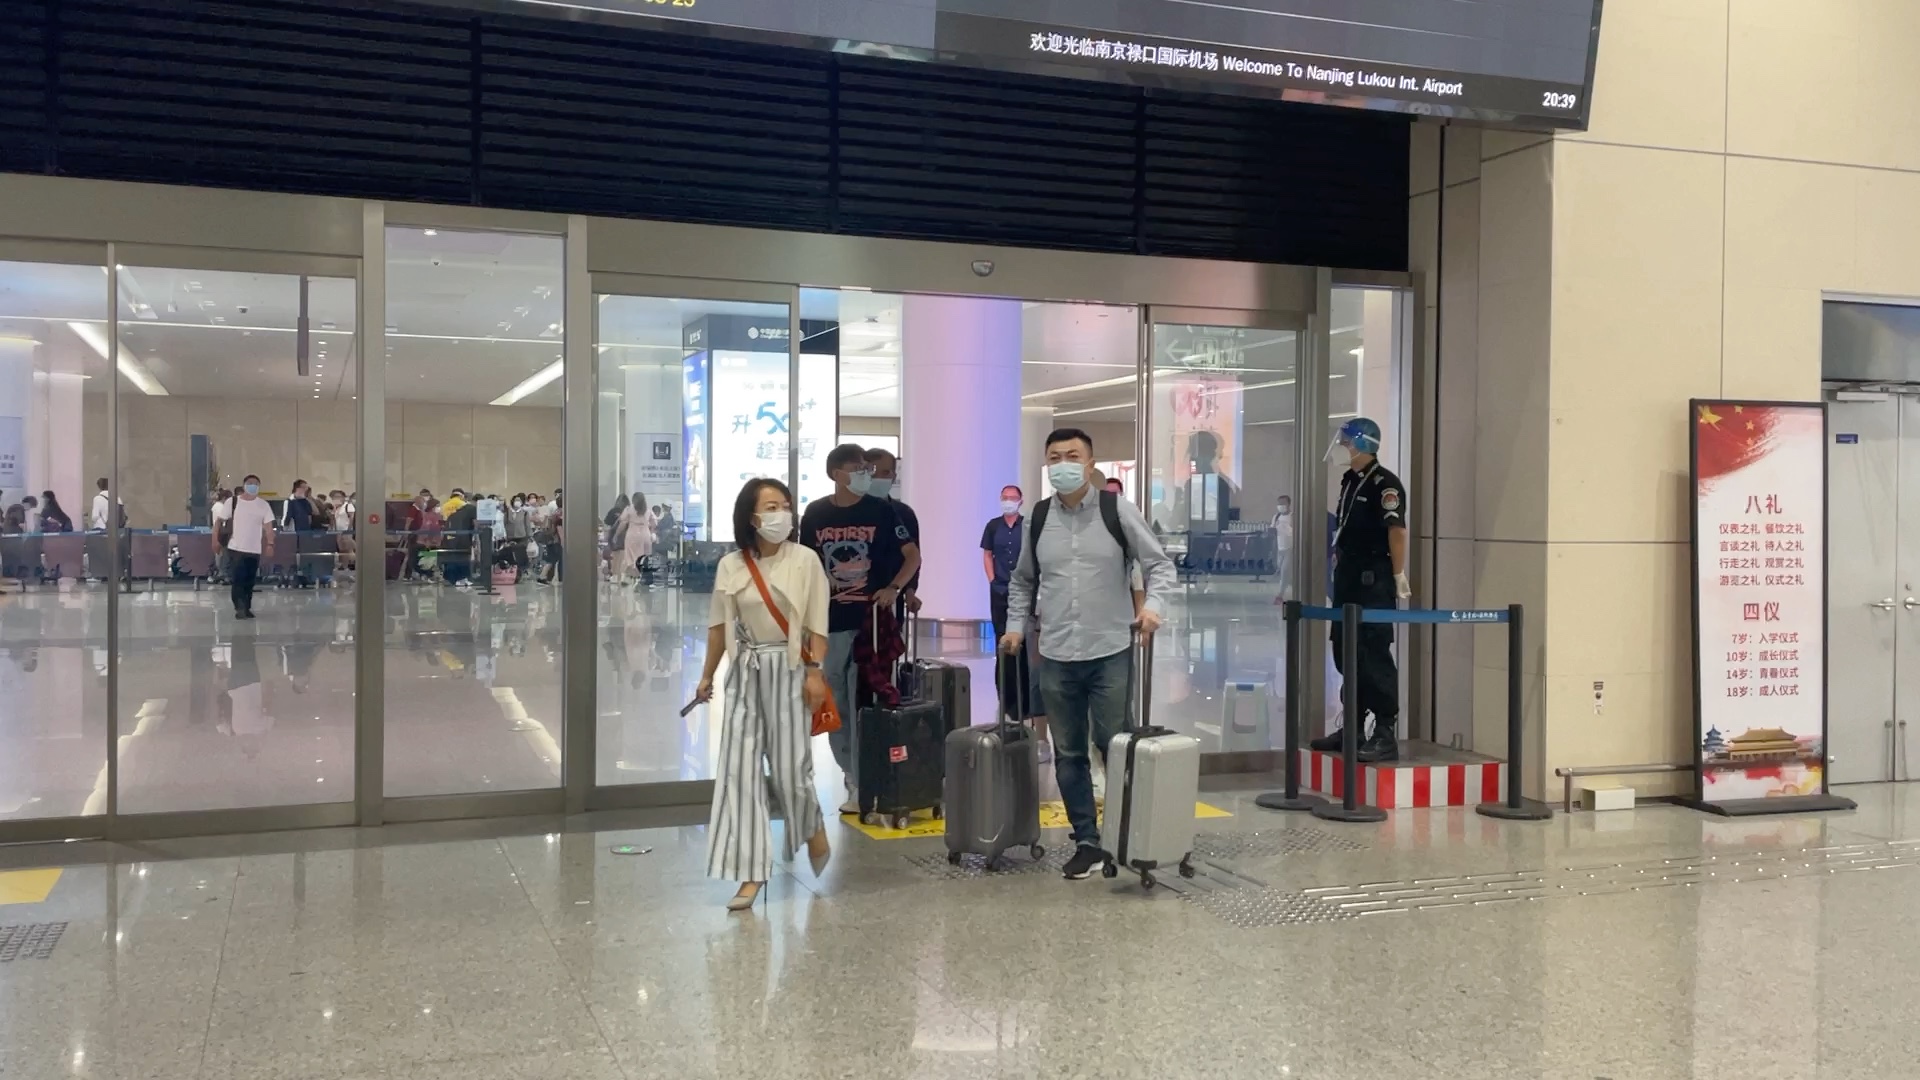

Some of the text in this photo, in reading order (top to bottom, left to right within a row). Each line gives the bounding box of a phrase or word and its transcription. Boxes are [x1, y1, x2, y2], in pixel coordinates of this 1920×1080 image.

[1030, 32, 1464, 96] 欢迎光临南京禄口国际机场 Welcome To Nanjing Lukou Int. Airport
[1542, 91, 1576, 109] 20:39
[1745, 494, 1782, 514] 八礼
[1719, 523, 1804, 534] 仪表之礼 餐饮之礼
[1720, 540, 1804, 551] 言谈之礼 待人之礼
[1720, 557, 1804, 569] 行走之礼 观赏之礼
[1720, 575, 1804, 586] 游览之礼 仪式之礼
[1743, 602, 1780, 622] 四仪
